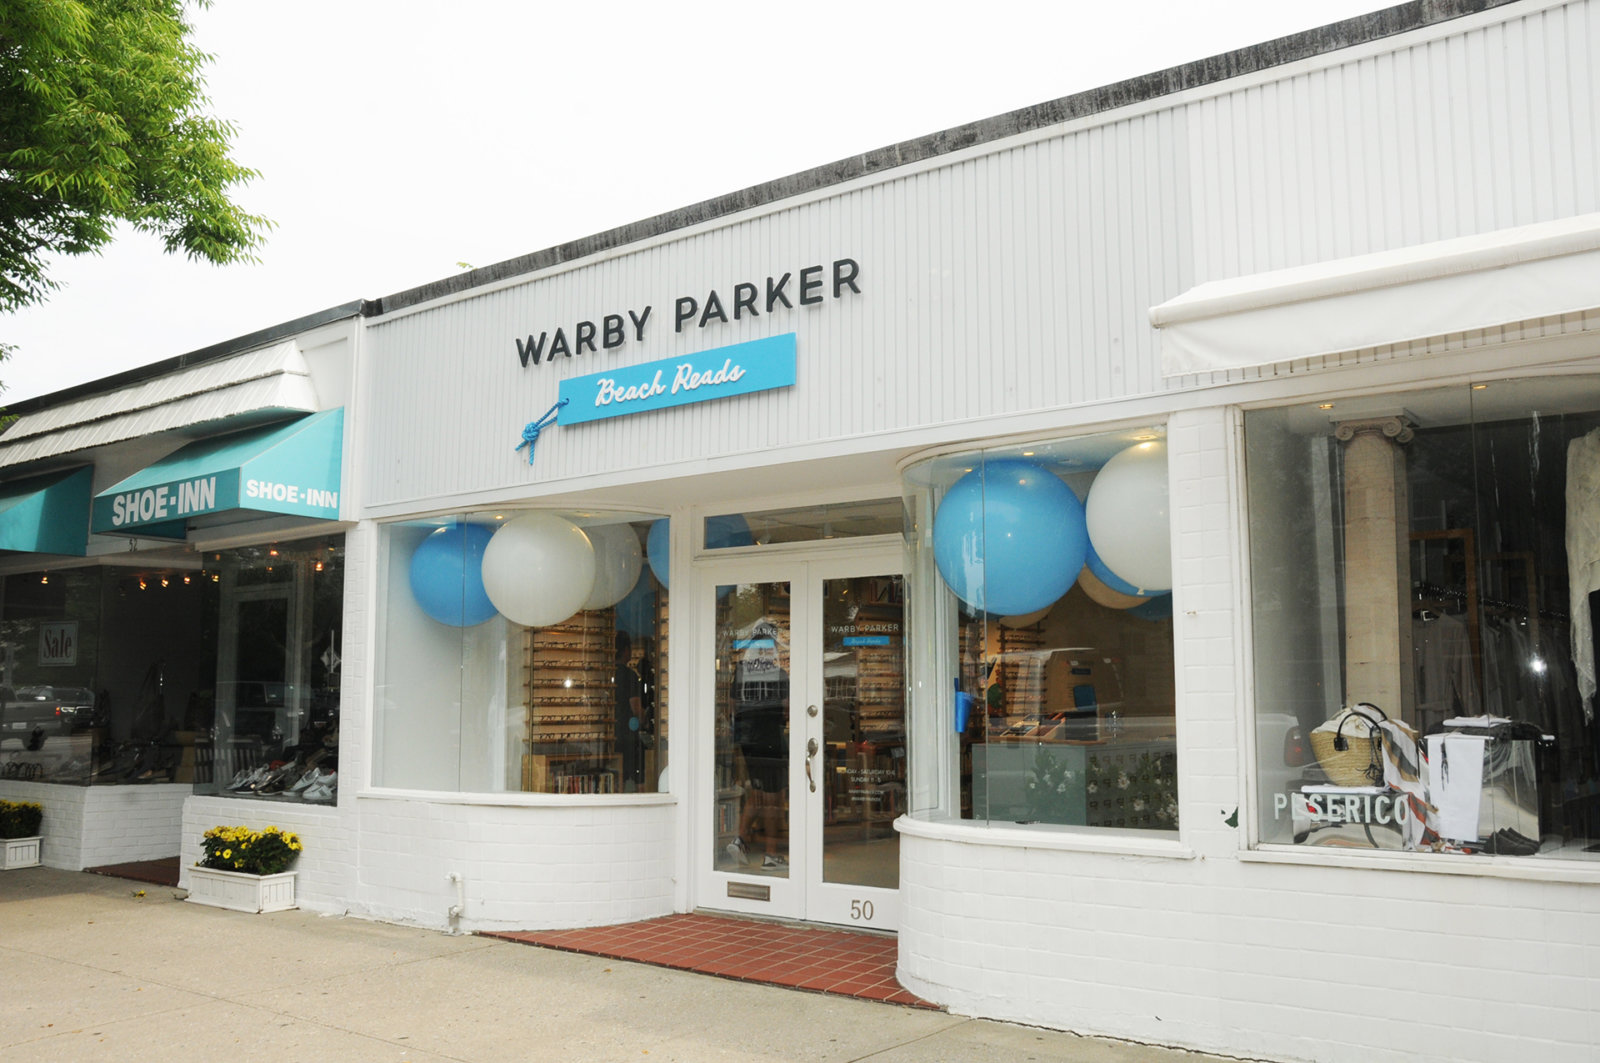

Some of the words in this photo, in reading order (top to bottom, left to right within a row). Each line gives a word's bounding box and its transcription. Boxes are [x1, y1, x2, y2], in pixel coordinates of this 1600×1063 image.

[516, 305, 652, 368] WARBY
[675, 258, 862, 333] PARKER
[594, 369, 666, 407] Beach
[671, 358, 746, 395] Reads
[43, 629, 73, 658] Sale
[831, 625, 861, 633] WARBY
[864, 623, 899, 632] PARKER
[1273, 792, 1410, 825] PESERICO
[850, 899, 875, 920] 50
